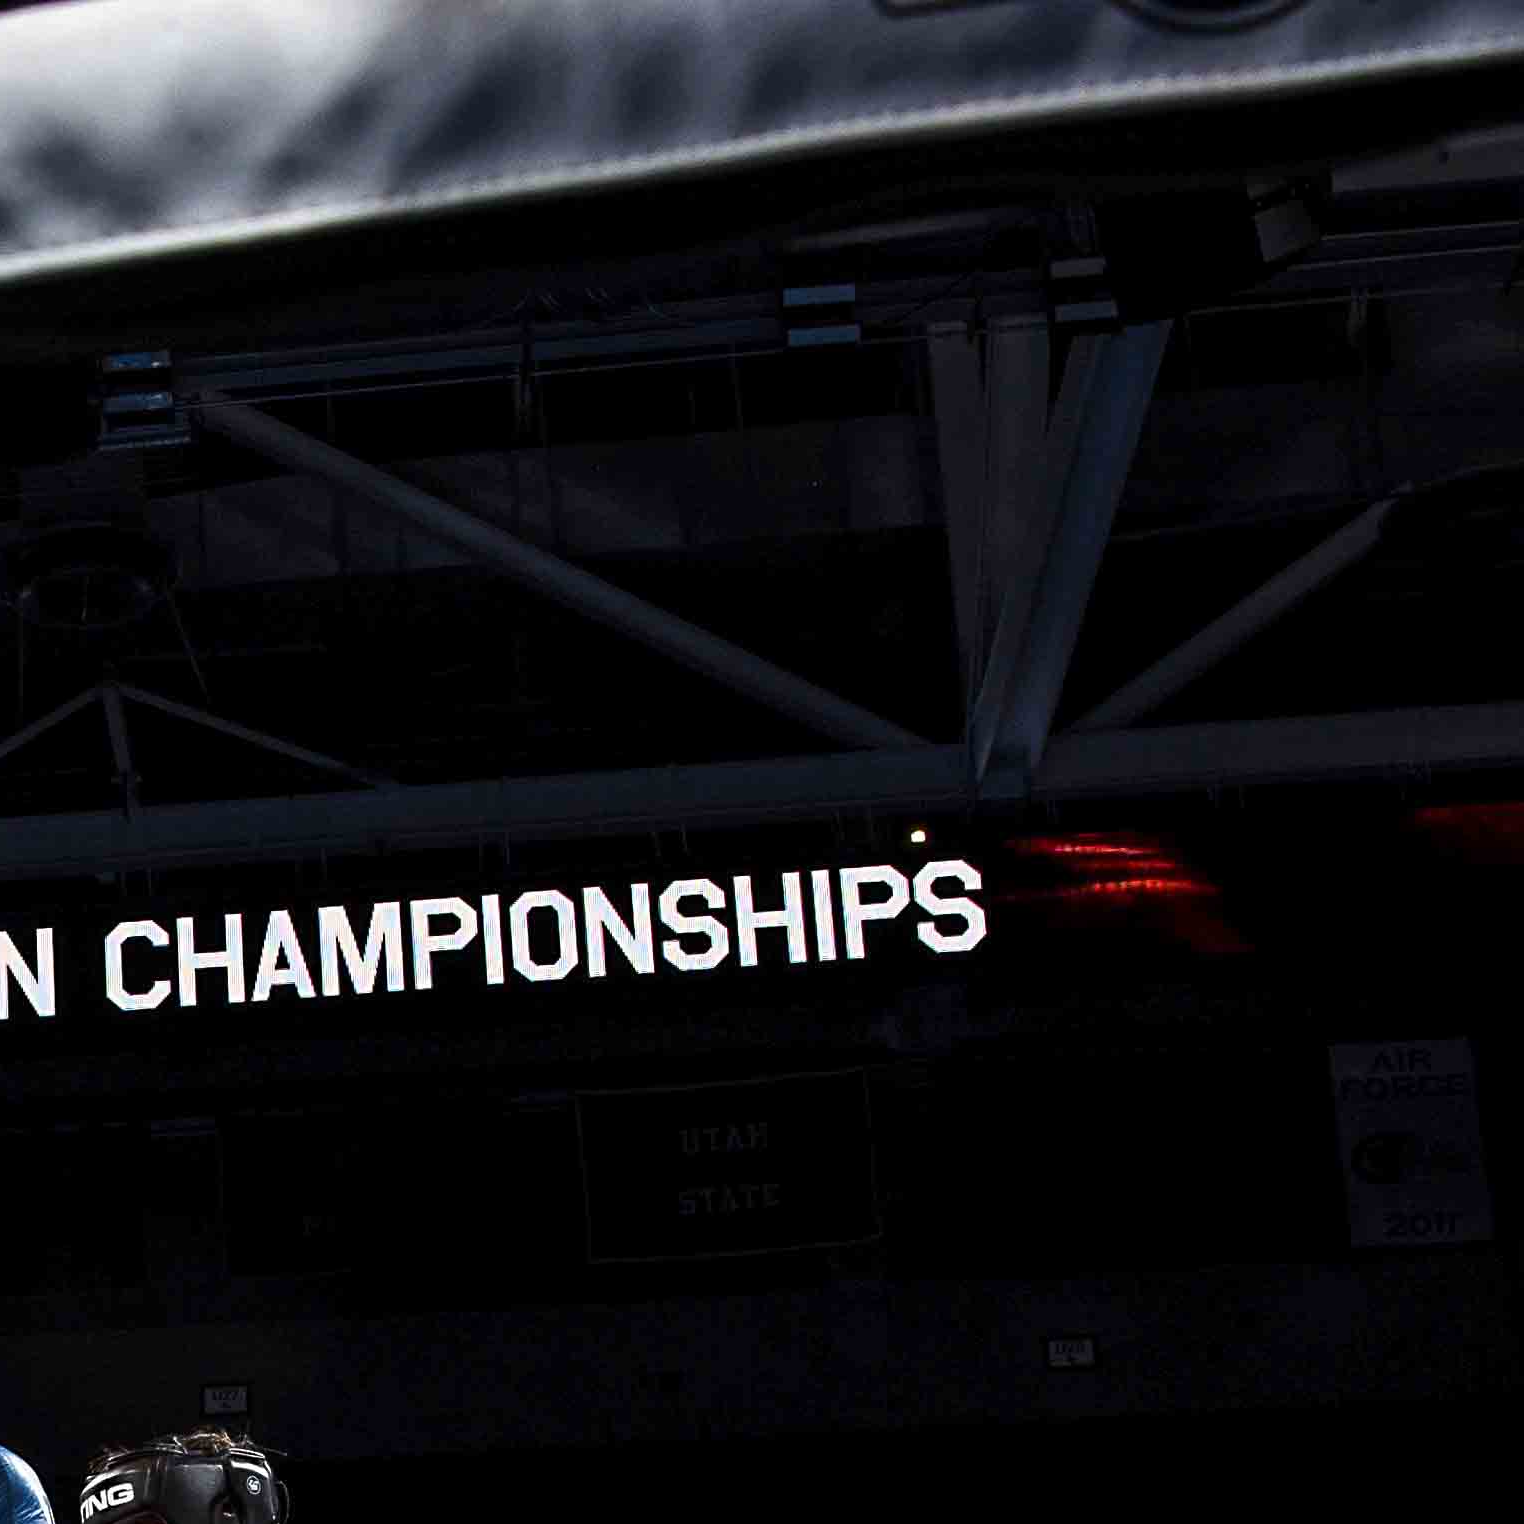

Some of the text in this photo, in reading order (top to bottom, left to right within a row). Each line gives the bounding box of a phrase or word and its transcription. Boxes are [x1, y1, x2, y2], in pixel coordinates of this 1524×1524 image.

[104, 860, 987, 1012] CHAMPIONSHIPS
[1372, 1048, 1432, 1073] AIR
[677, 1121, 769, 1157] UTAH
[677, 1182, 781, 1216] STATE
